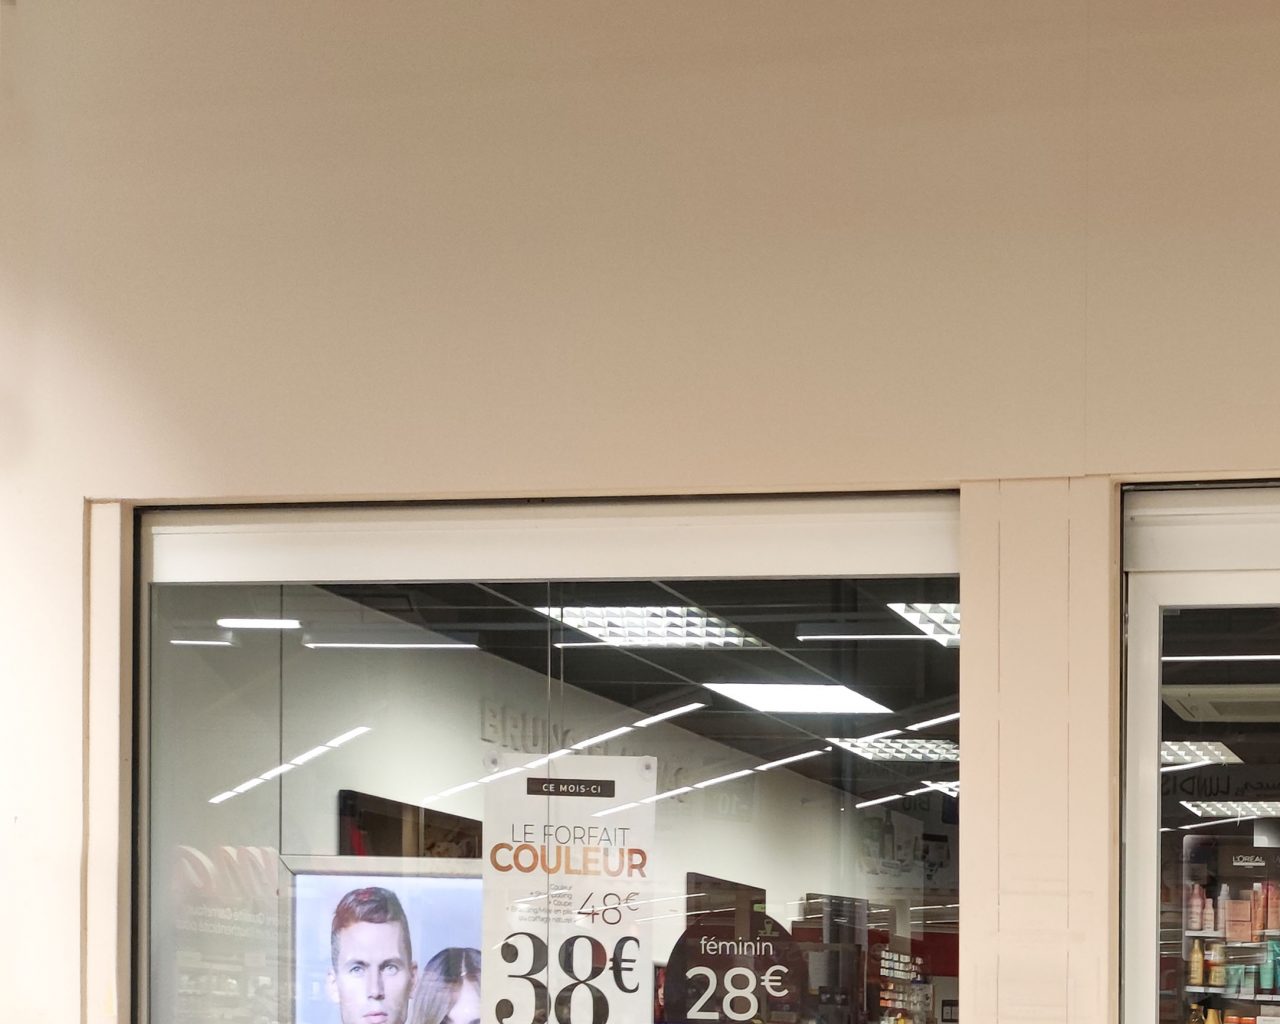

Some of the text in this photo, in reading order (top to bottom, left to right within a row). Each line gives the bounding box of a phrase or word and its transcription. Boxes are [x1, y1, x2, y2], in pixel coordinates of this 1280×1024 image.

[542, 783, 601, 793] CE MOIS-CI
[511, 823, 630, 847] LE FORFAIT
[490, 842, 648, 878] COULEUR
[577, 892, 640, 925] 48€
[699, 936, 774, 957] féminin
[685, 965, 790, 1022] 28€
